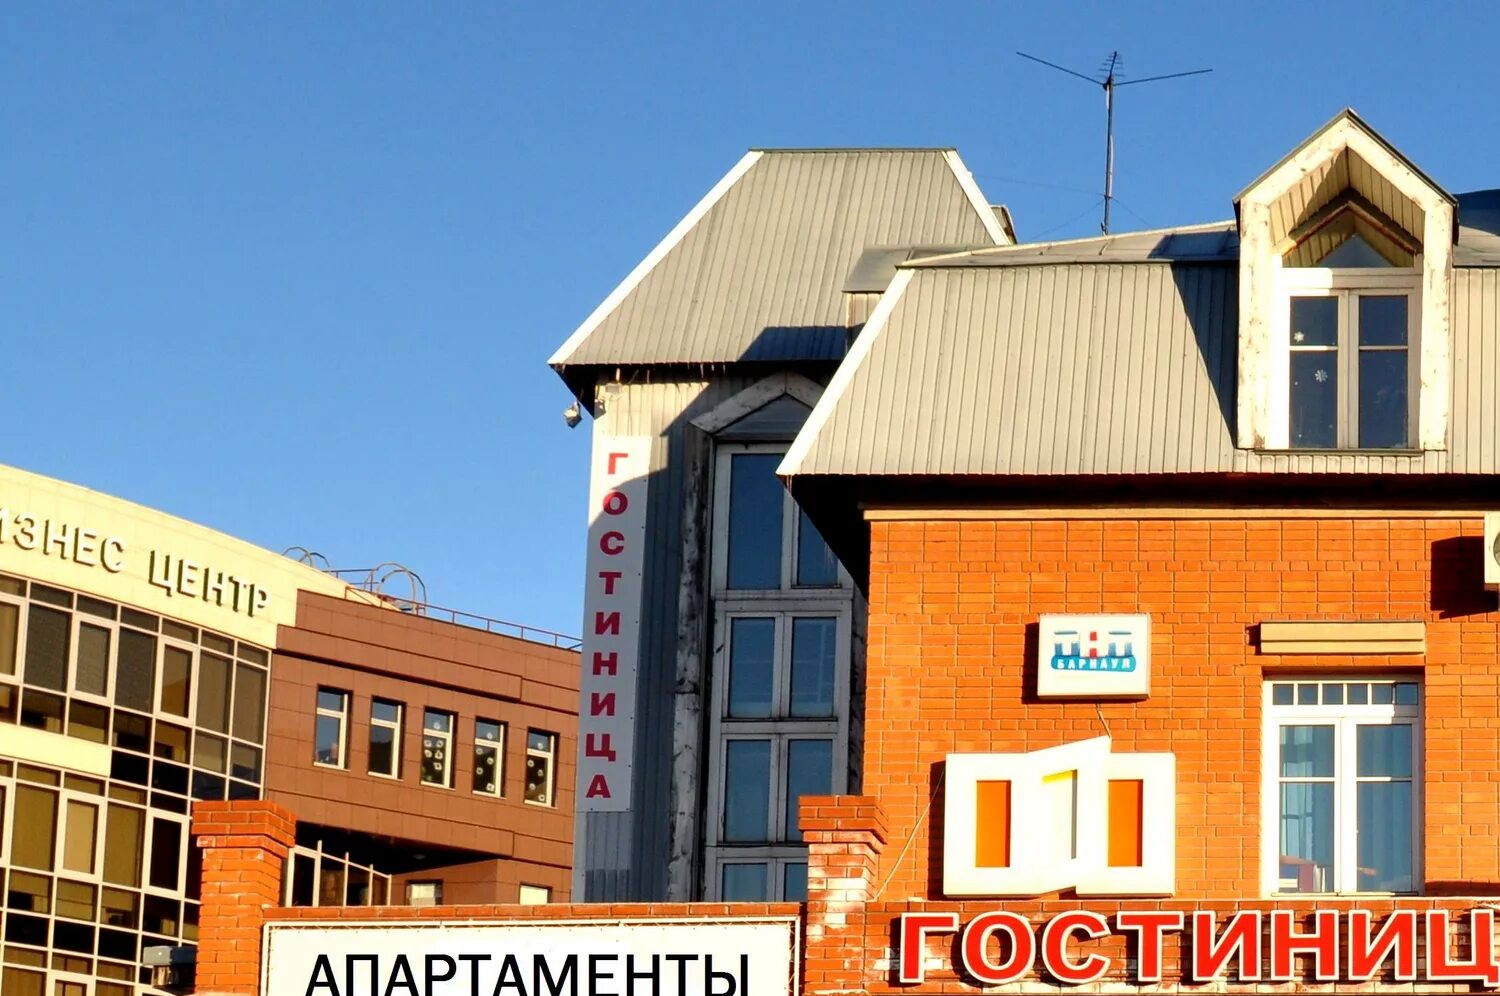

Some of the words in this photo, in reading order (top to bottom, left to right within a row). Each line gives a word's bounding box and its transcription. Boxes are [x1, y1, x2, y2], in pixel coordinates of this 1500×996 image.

[149, 549, 272, 618] ЦЕНТР
[584, 452, 628, 799] ГОСТИНИЦА
[1056, 658, 1131, 671] БАРНАУЛ
